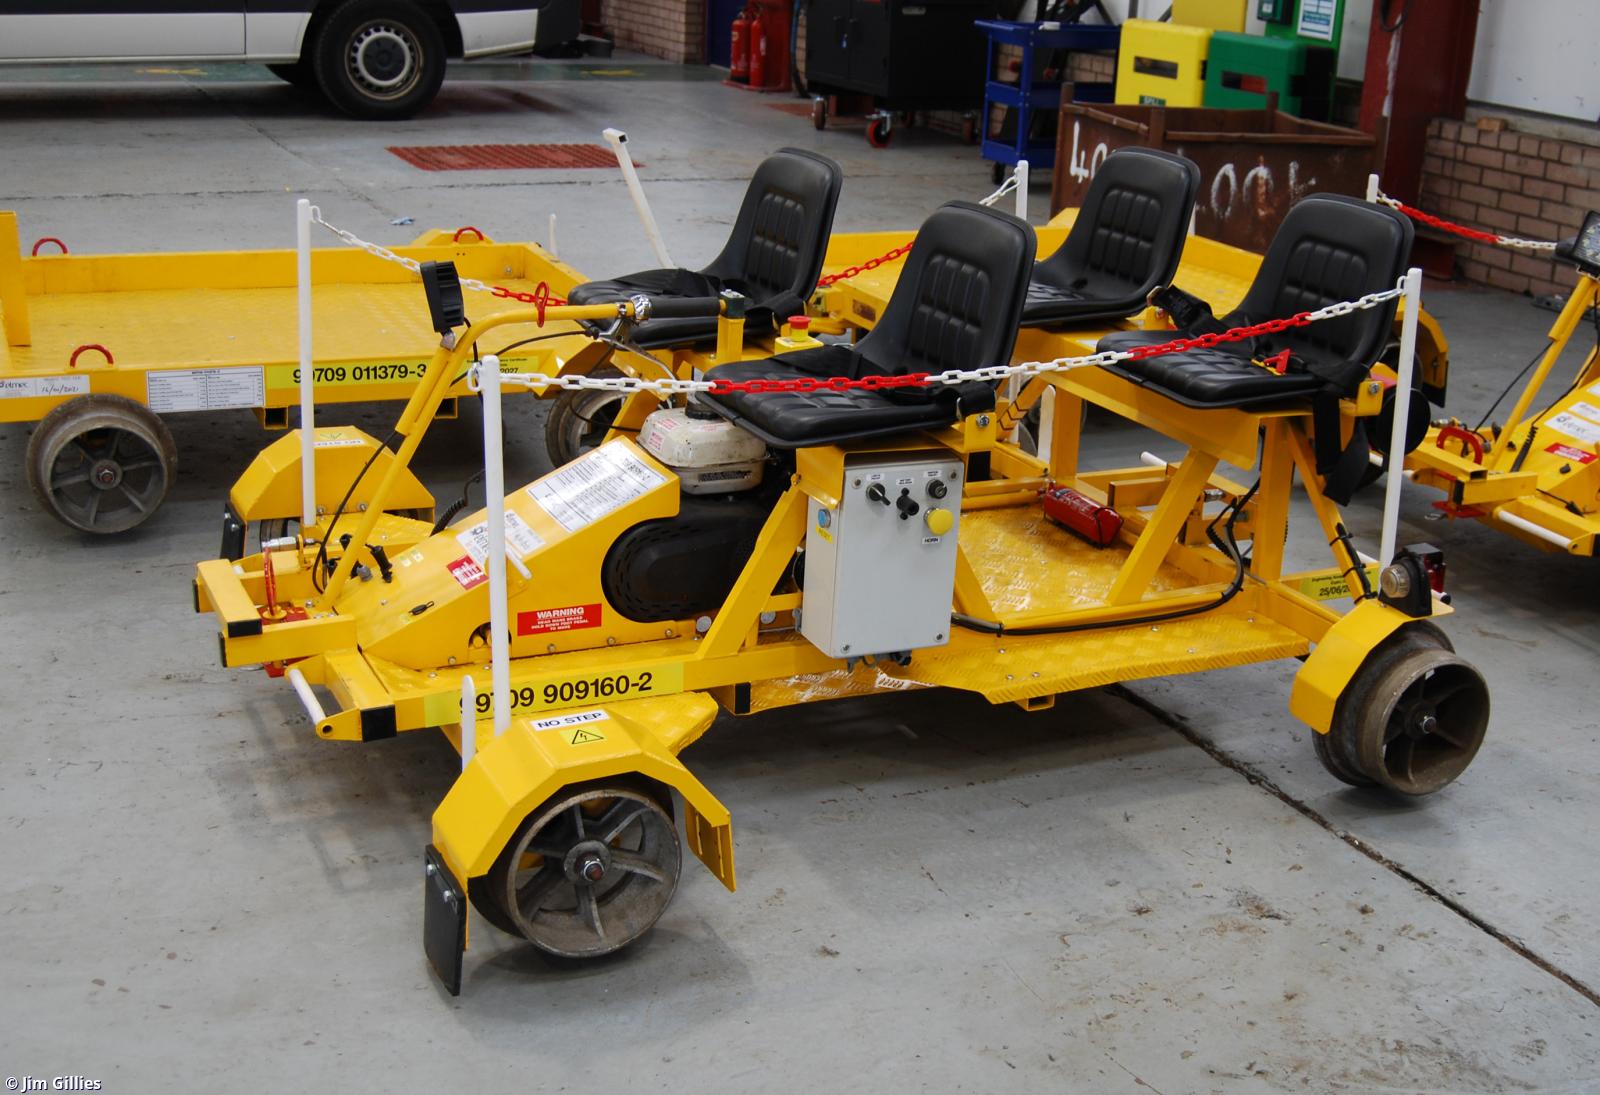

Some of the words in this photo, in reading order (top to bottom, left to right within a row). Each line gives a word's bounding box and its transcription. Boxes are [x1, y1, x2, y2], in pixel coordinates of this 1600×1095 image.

[293, 367, 346, 383] 9709
[352, 363, 428, 381] 011379-3
[1319, 585, 1350, 597] 25/06/2
[537, 607, 584, 619] WARNING
[459, 687, 535, 714] 909
[543, 672, 653, 704] 909160-2
[537, 720, 560, 729] NO
[564, 713, 602, 723] STEP
